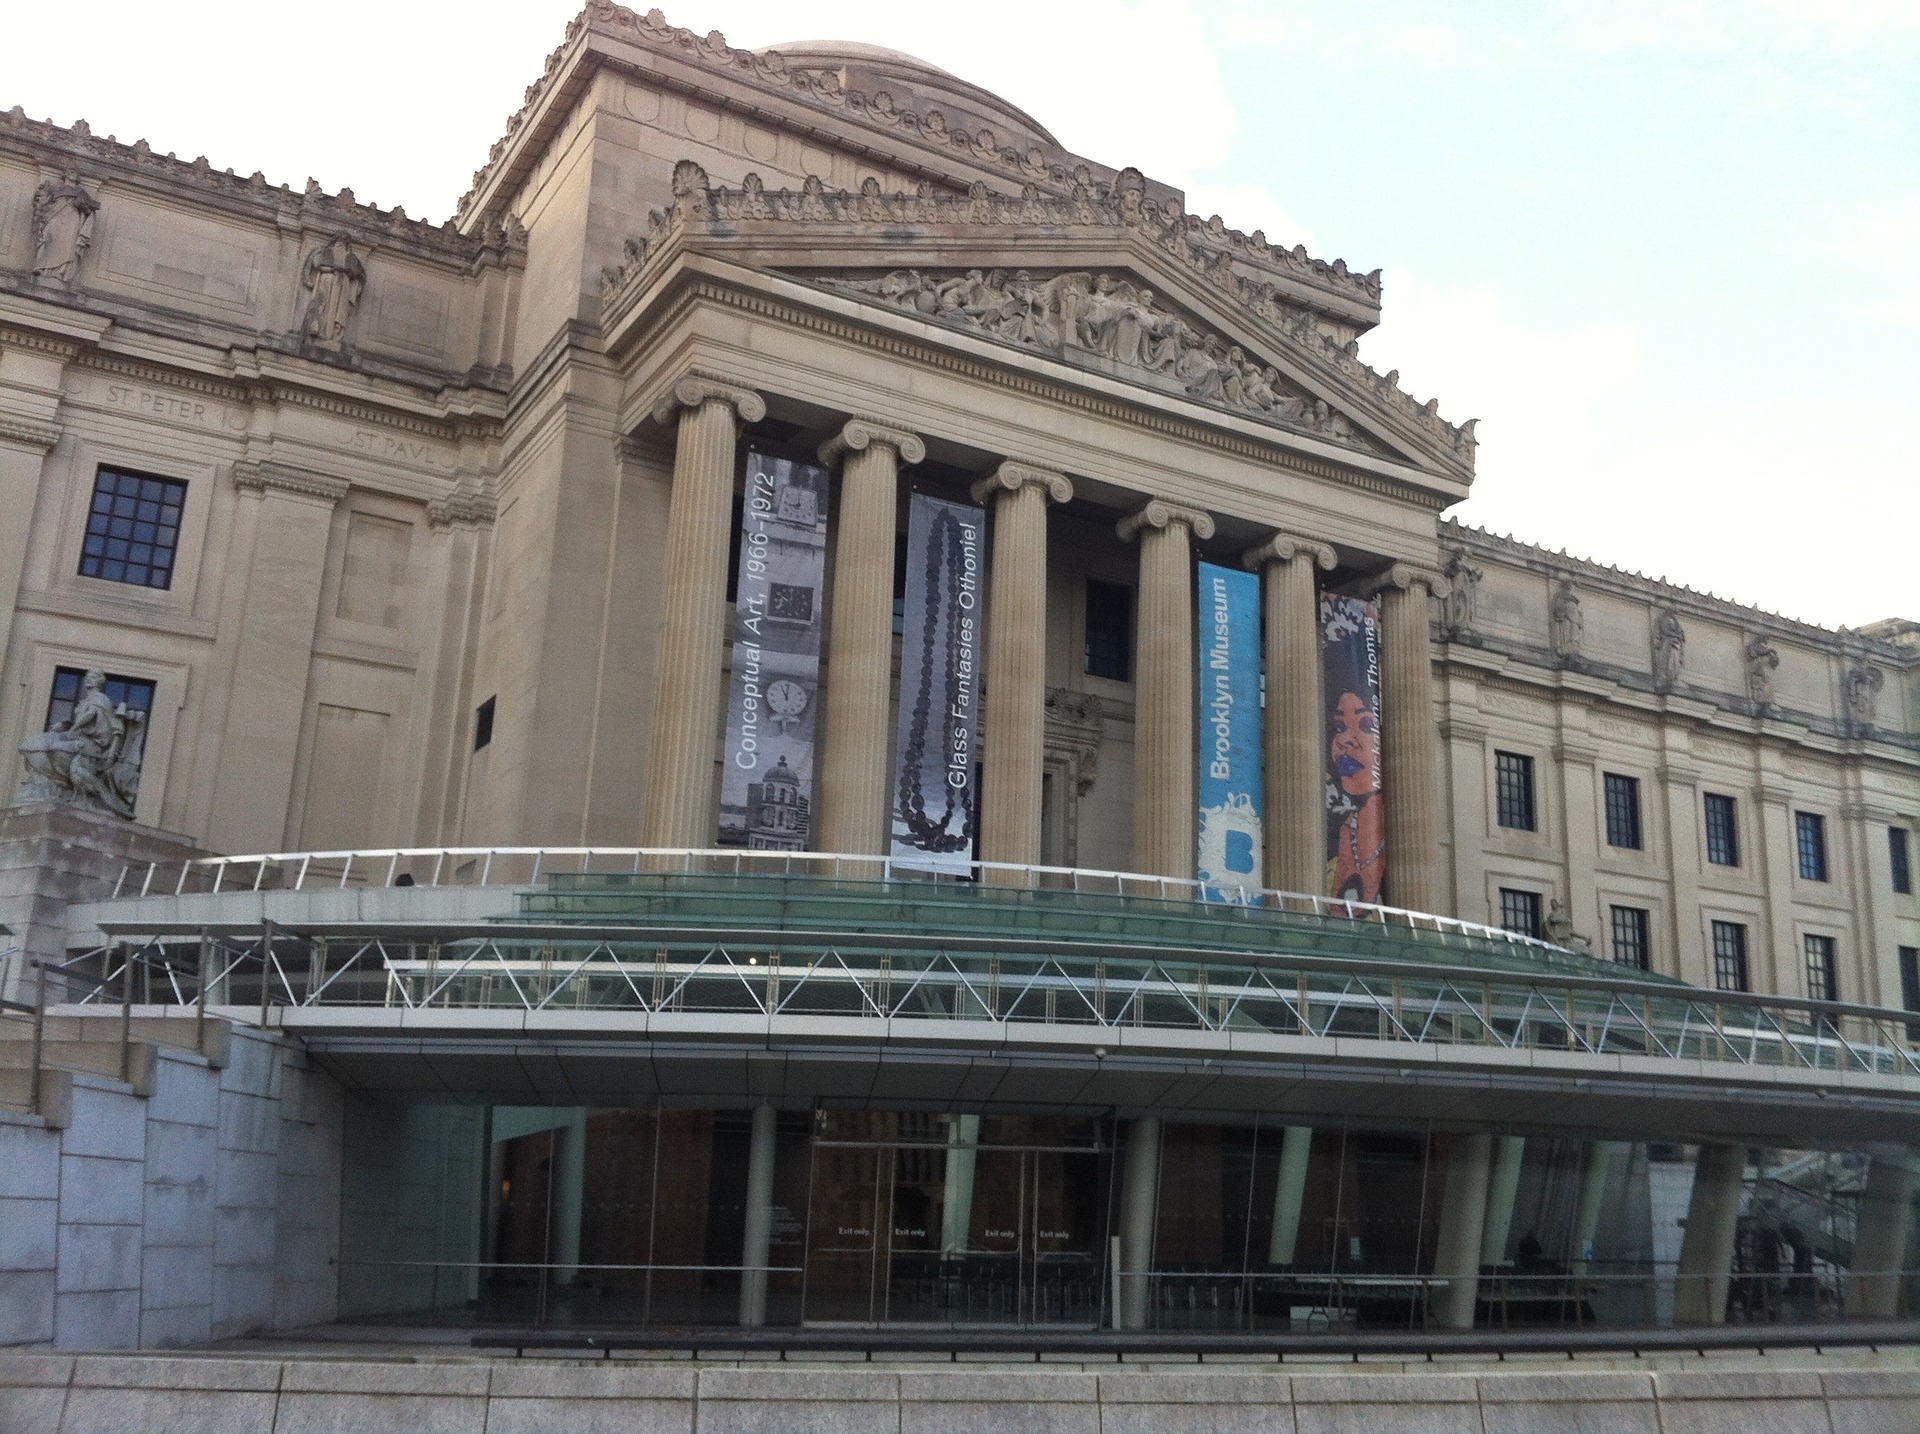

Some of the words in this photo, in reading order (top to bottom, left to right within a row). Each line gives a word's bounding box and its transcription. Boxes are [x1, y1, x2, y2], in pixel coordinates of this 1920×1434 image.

[140, 391, 206, 422] PETER
[958, 523, 977, 609] Othoniel
[743, 588, 767, 636] Art,
[1210, 577, 1229, 670] Museum
[951, 616, 974, 720] Fantasies
[1363, 616, 1379, 688] Thomas
[736, 641, 763, 771] Conceptual
[1209, 674, 1234, 780] Brooklyn
[948, 726, 967, 789] Glass
[1225, 829, 1254, 874] B
